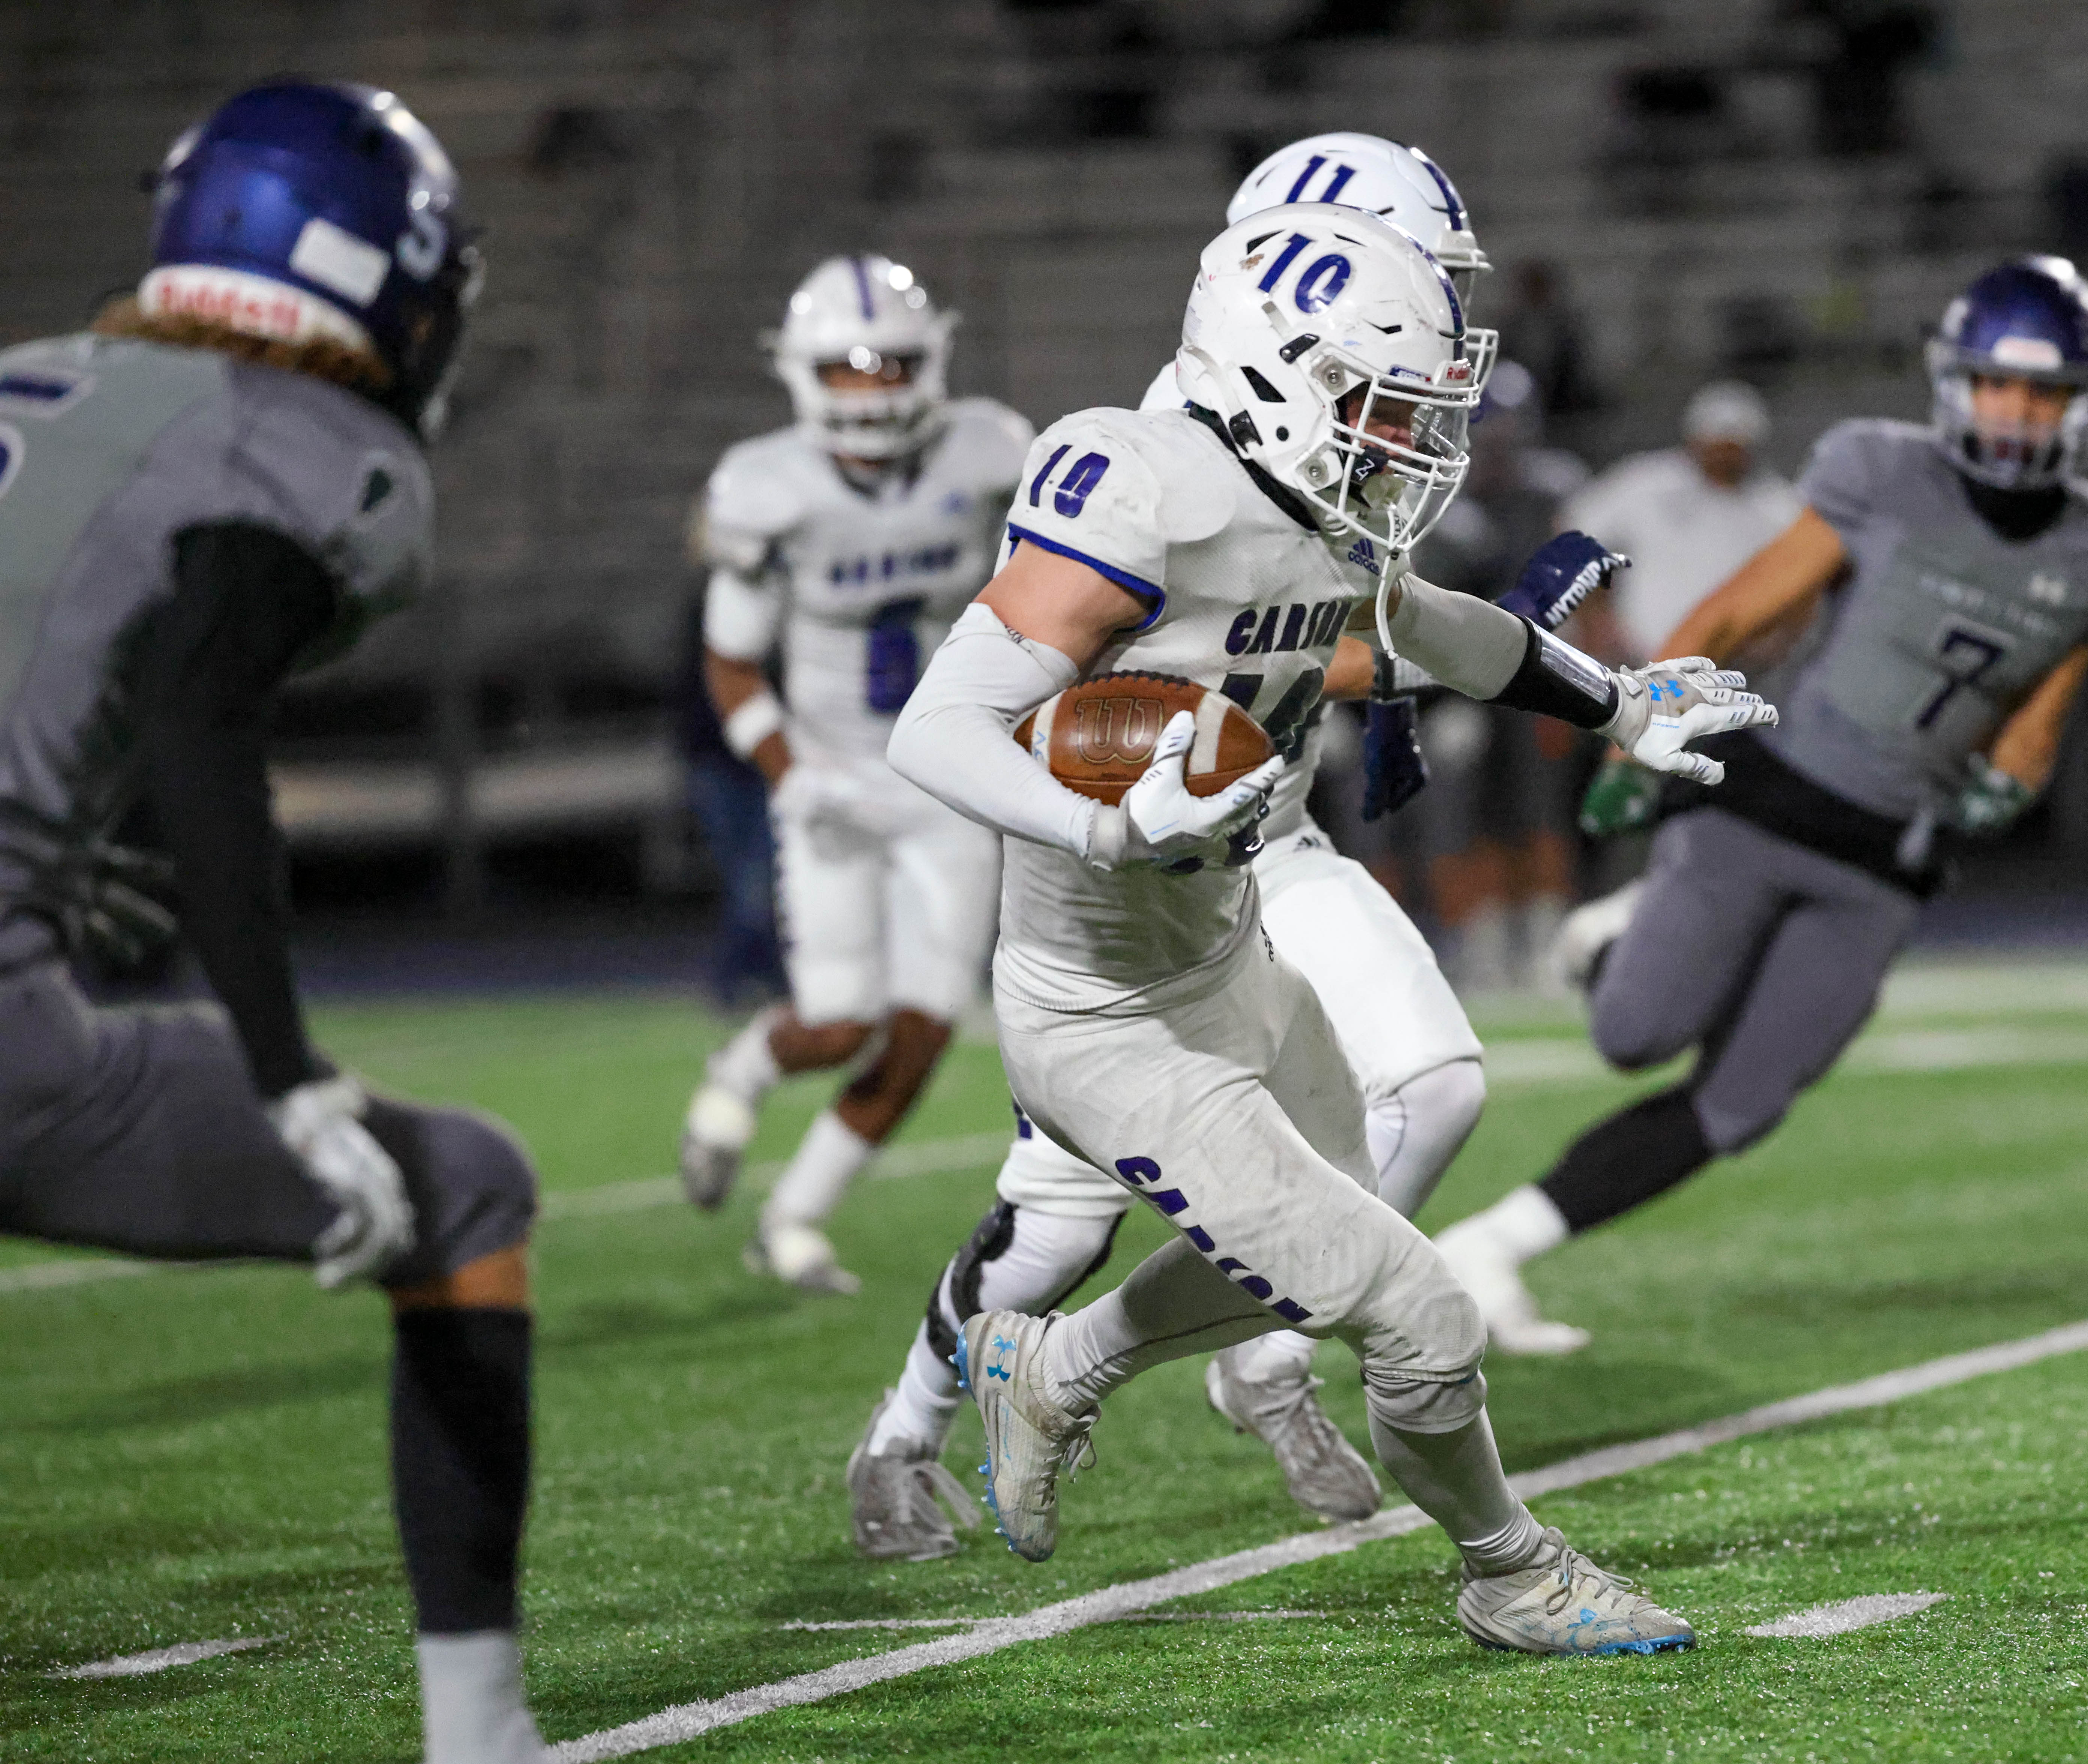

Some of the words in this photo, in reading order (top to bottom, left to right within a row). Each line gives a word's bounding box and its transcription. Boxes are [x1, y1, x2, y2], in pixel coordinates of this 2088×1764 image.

[1258, 232, 1352, 314] 10
[1030, 444, 1110, 518] 10
[1916, 619, 2012, 730] 7
